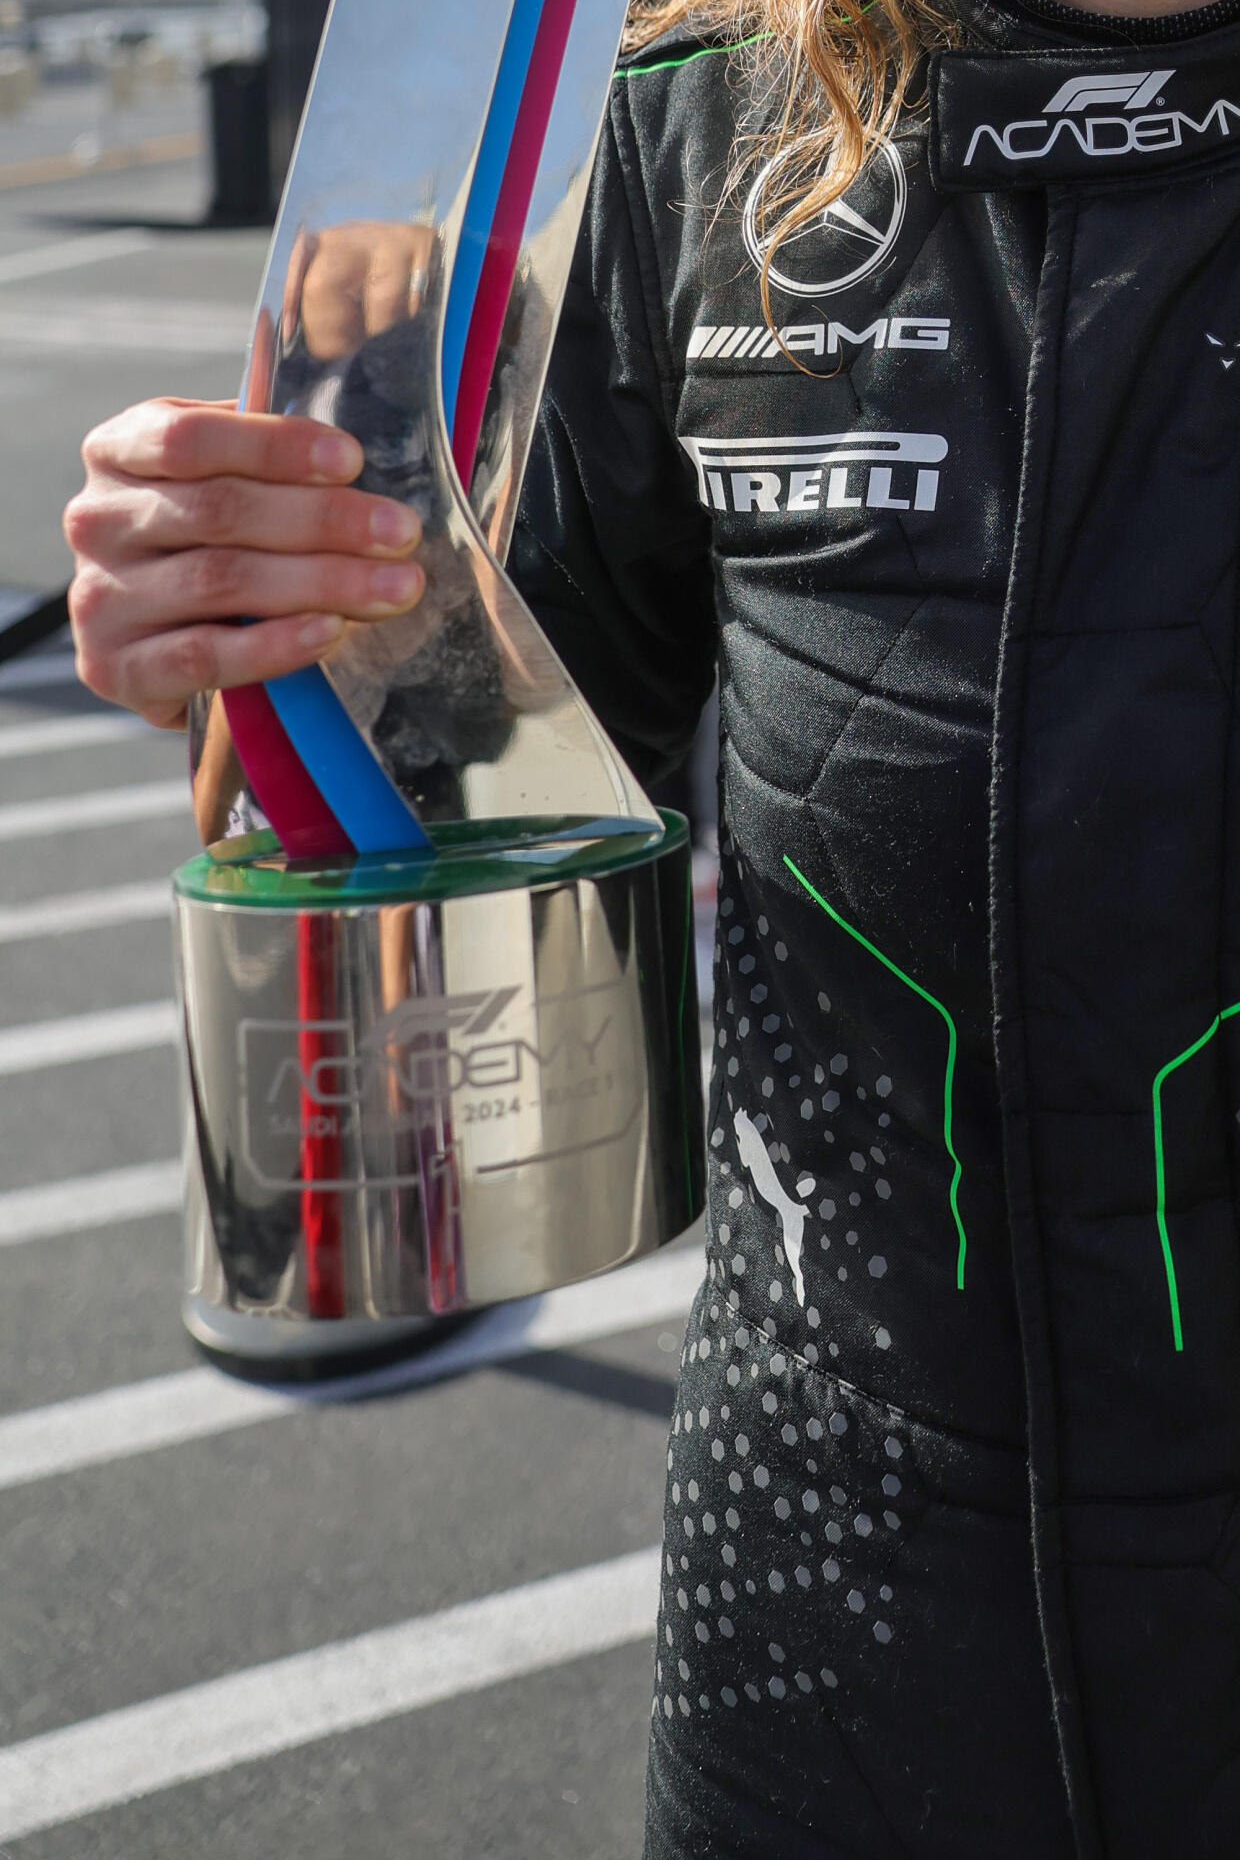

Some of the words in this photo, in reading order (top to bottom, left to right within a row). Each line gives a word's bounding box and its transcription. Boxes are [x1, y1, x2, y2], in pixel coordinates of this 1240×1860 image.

[1041, 70, 1177, 113] F1
[678, 431, 949, 513] PIRELLI
[463, 1096, 522, 1125] 2024
